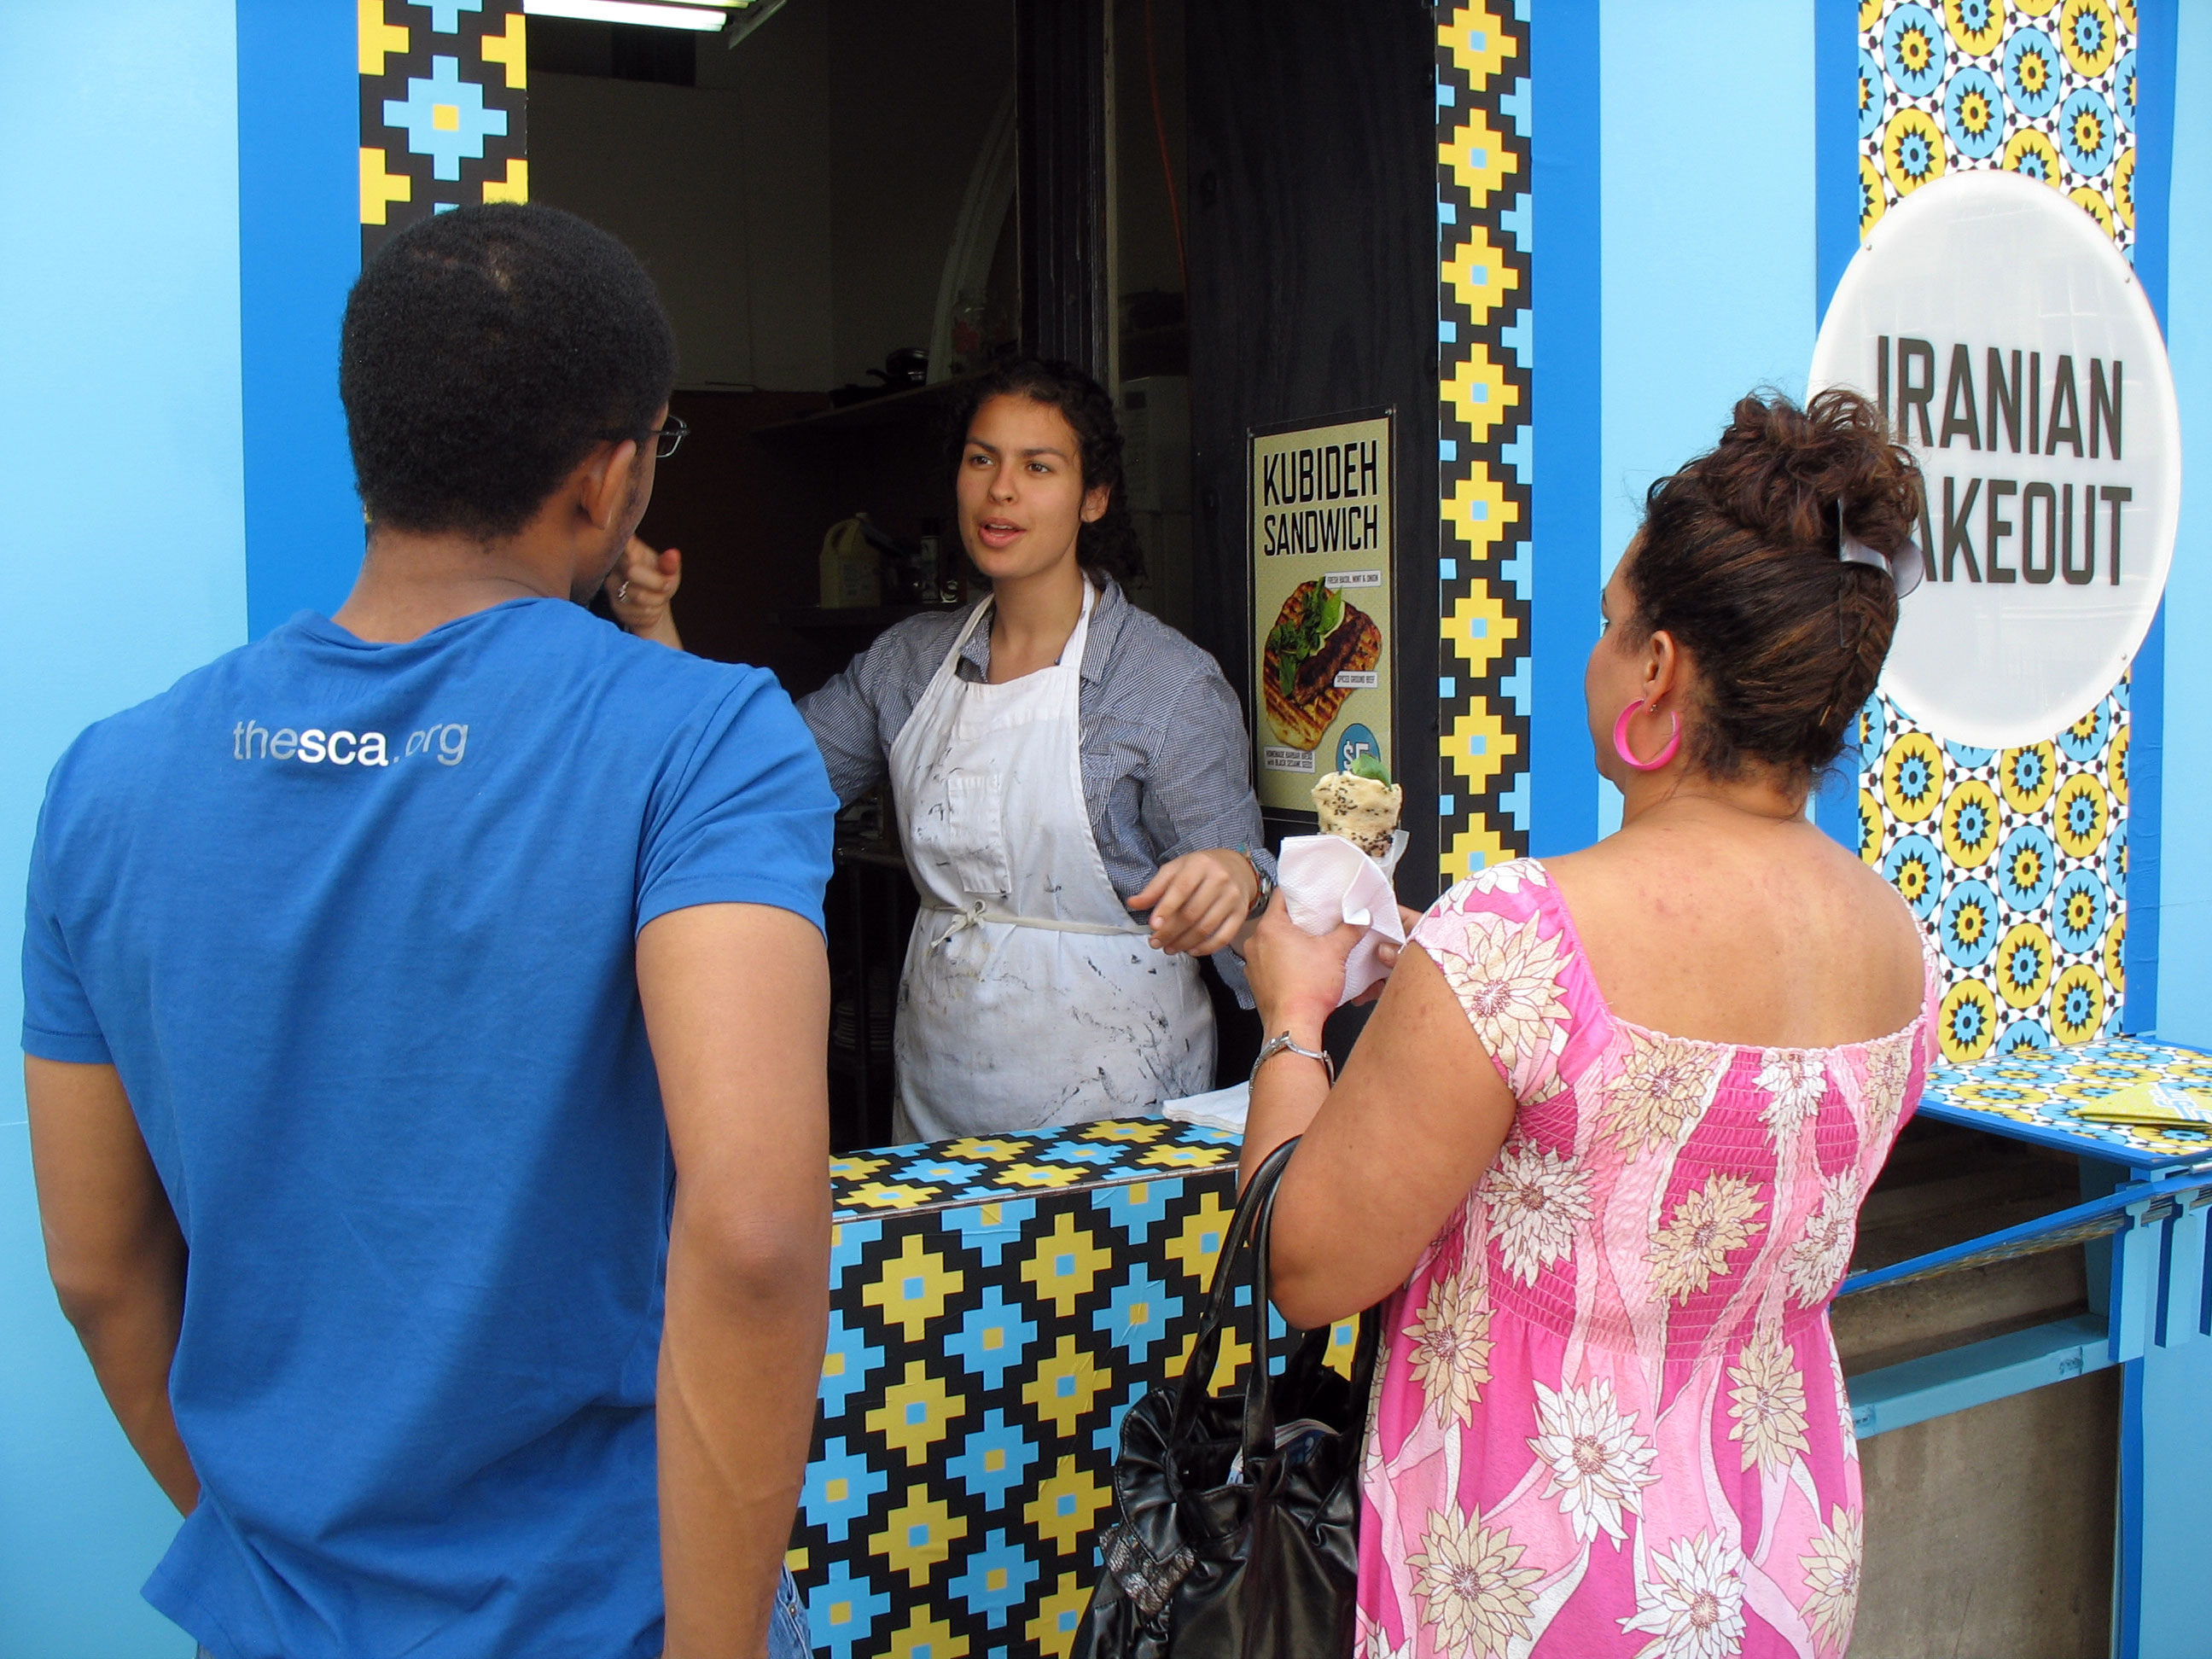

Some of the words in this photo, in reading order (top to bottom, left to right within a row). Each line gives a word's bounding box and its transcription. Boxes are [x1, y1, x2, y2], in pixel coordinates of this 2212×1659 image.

[1877, 335, 2122, 461] IRANIAN
[1263, 439, 1377, 507] KUBIDEH
[1263, 504, 1378, 556] SANDWICH
[1917, 476, 2133, 586] KEOUT
[233, 719, 469, 767] thesca.org
